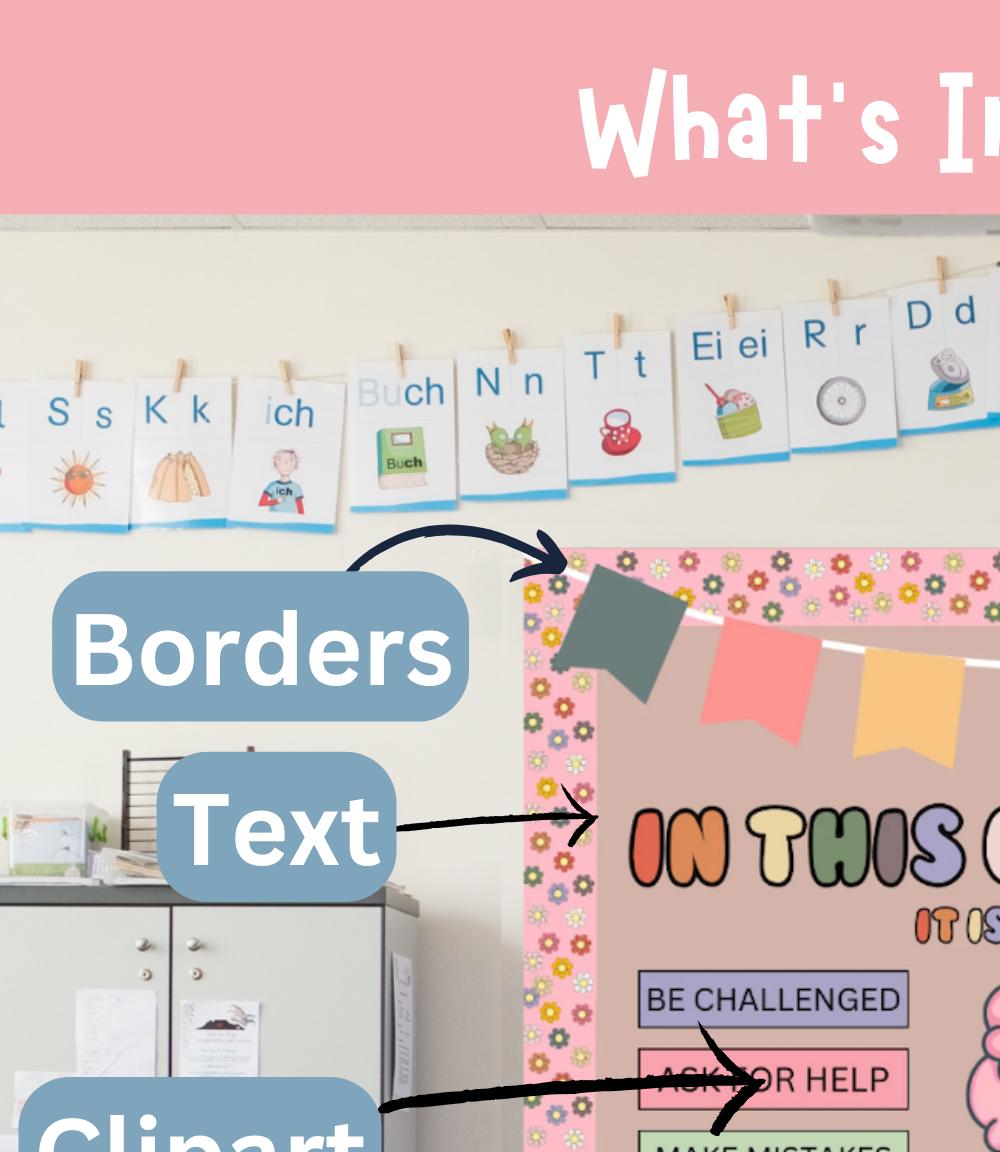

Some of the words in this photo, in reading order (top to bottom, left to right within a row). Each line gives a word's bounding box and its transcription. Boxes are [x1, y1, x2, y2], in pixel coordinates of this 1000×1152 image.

[907, 299, 934, 331] D
[955, 295, 977, 325] d
[692, 330, 723, 362] Ei
[738, 334, 769, 359] ei
[803, 319, 828, 350] R
[854, 323, 867, 346] r
[583, 349, 607, 381] T
[634, 349, 649, 379] t
[357, 376, 445, 408] Buch
[475, 366, 501, 397] N
[523, 371, 544, 396] n
[47, 395, 71, 427] S
[95, 405, 113, 430] s
[144, 394, 169, 425] K
[192, 394, 211, 424] k
[265, 395, 315, 428] ich
[386, 455, 424, 471] Buch
[628, 805, 731, 888] IN
[744, 802, 967, 889] THIS
[914, 906, 960, 945] IT
[647, 987, 686, 1012] BE
[694, 987, 901, 1012] CHALLENGED
[806, 1066, 890, 1092] HELP
